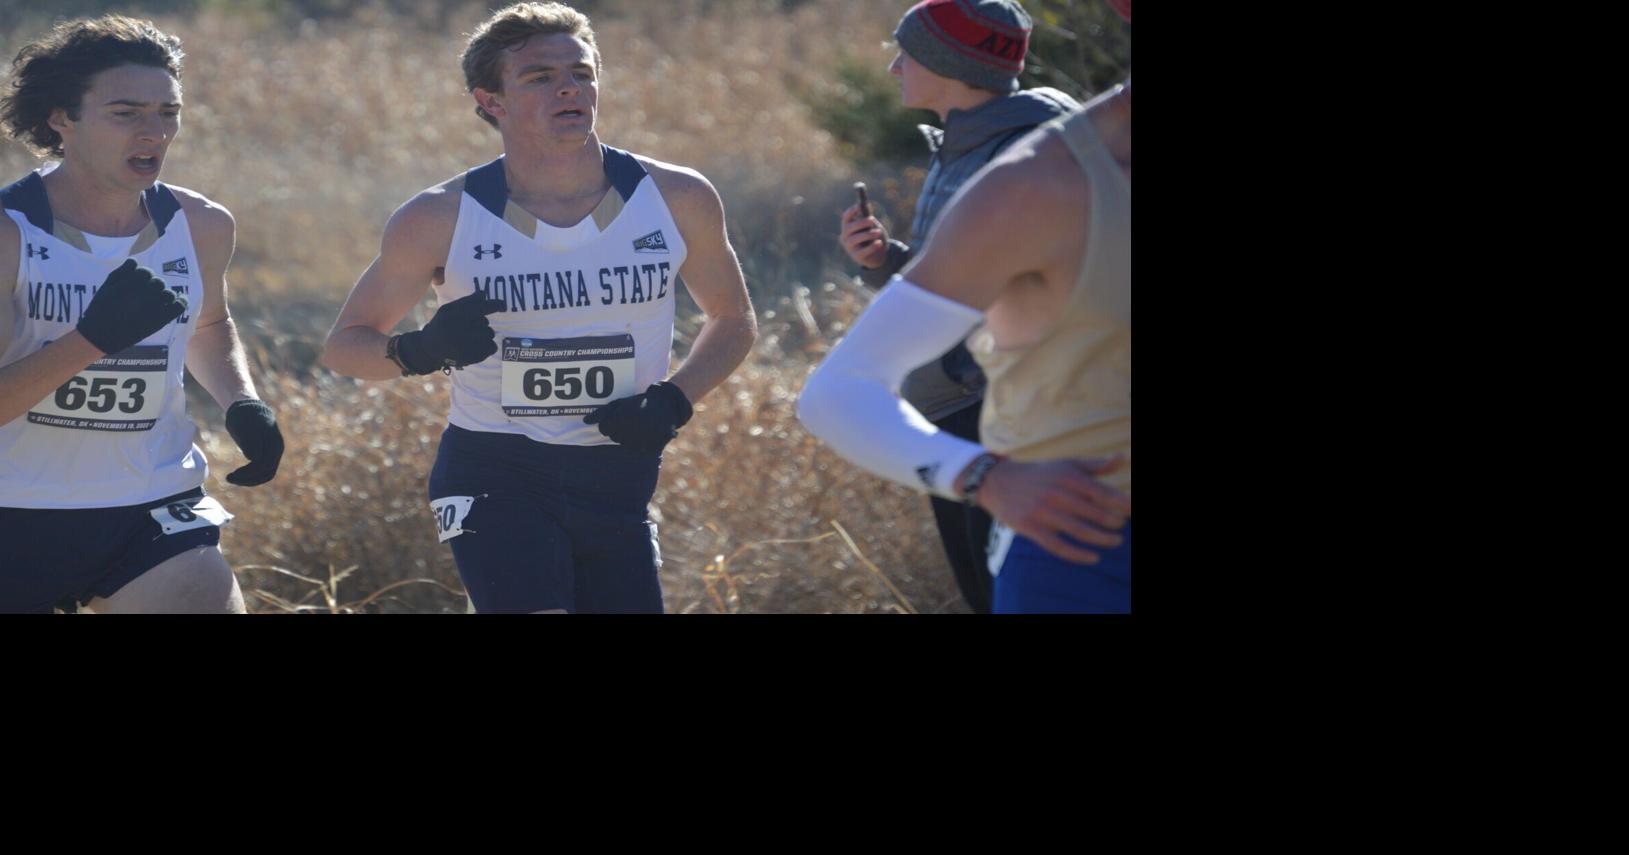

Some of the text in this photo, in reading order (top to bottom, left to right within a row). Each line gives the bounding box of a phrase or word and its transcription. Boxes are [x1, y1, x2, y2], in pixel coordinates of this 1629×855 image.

[474, 261, 670, 312] MONTANA STATE
[117, 358, 167, 366] CHAMPIONSHIPS
[544, 349, 576, 357] COUNTRY
[577, 346, 633, 355] CHAMPIONSHIPS
[54, 375, 147, 414] 653
[522, 365, 615, 401] 650
